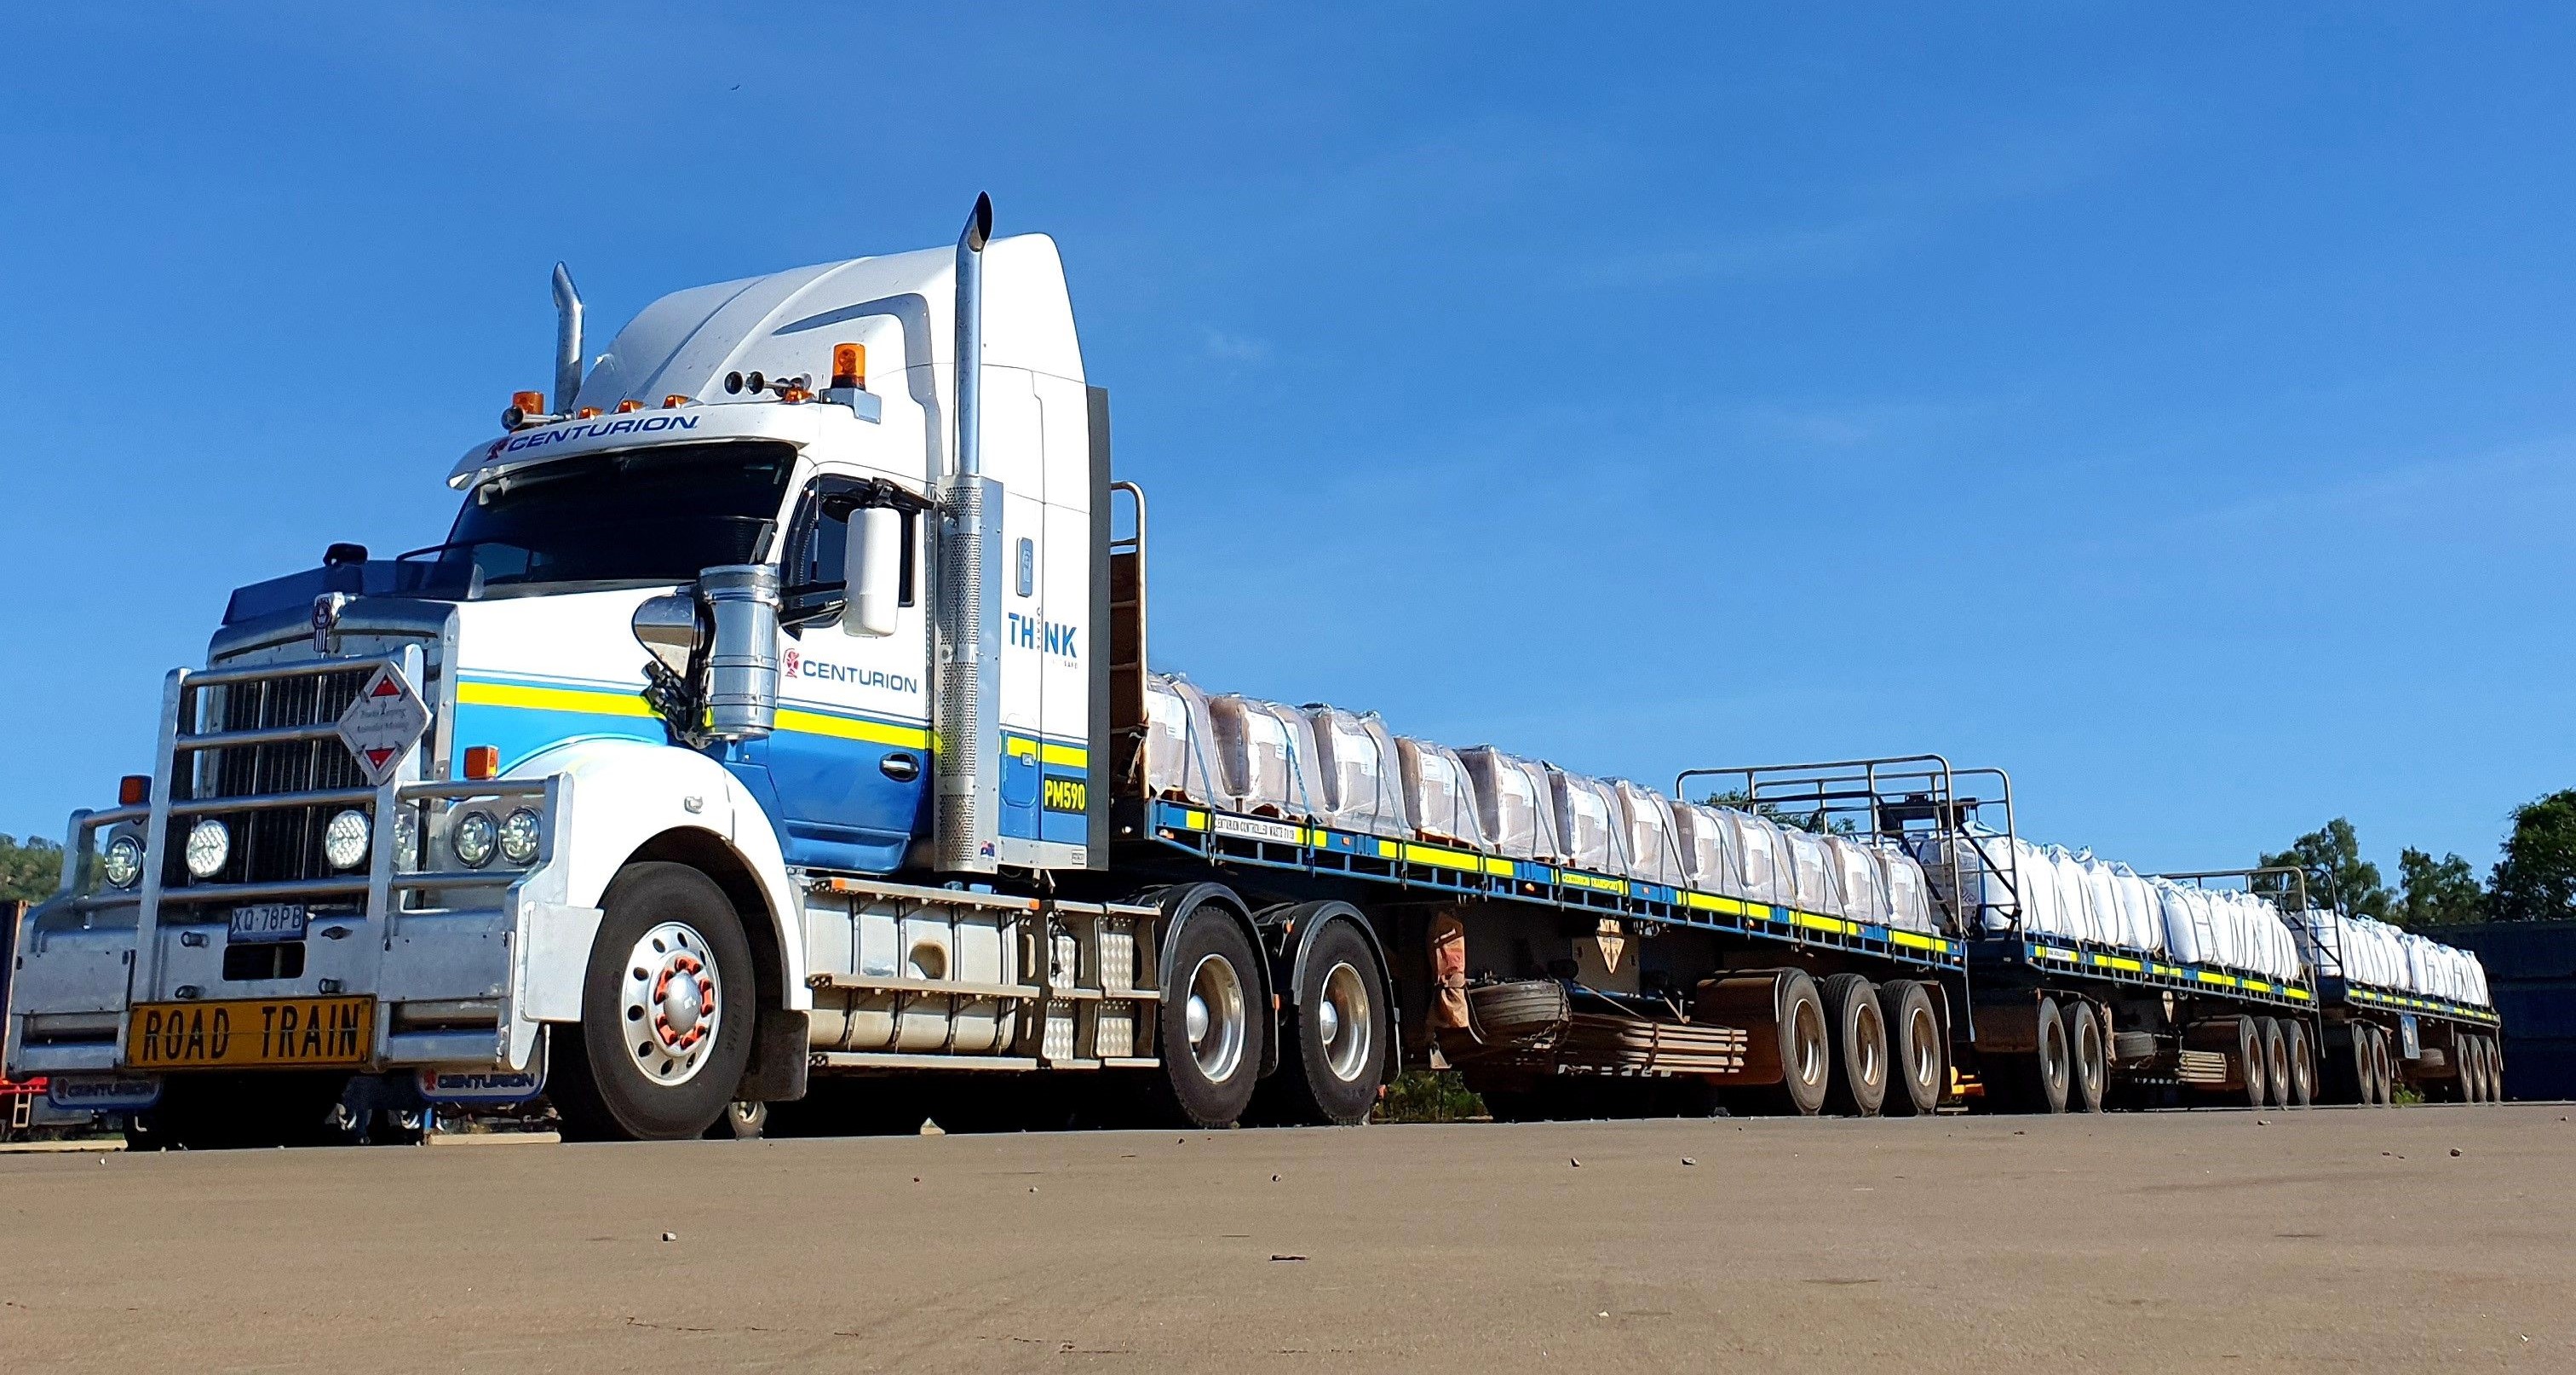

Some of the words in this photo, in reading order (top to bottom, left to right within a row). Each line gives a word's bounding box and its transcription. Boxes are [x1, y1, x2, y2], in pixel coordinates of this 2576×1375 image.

[507, 415, 700, 452] CENTURION
[802, 659, 917, 694] CENTURION
[1044, 779, 1086, 811] PM590
[142, 1006, 231, 1061] ROAD
[262, 1003, 359, 1058] TRAIN
